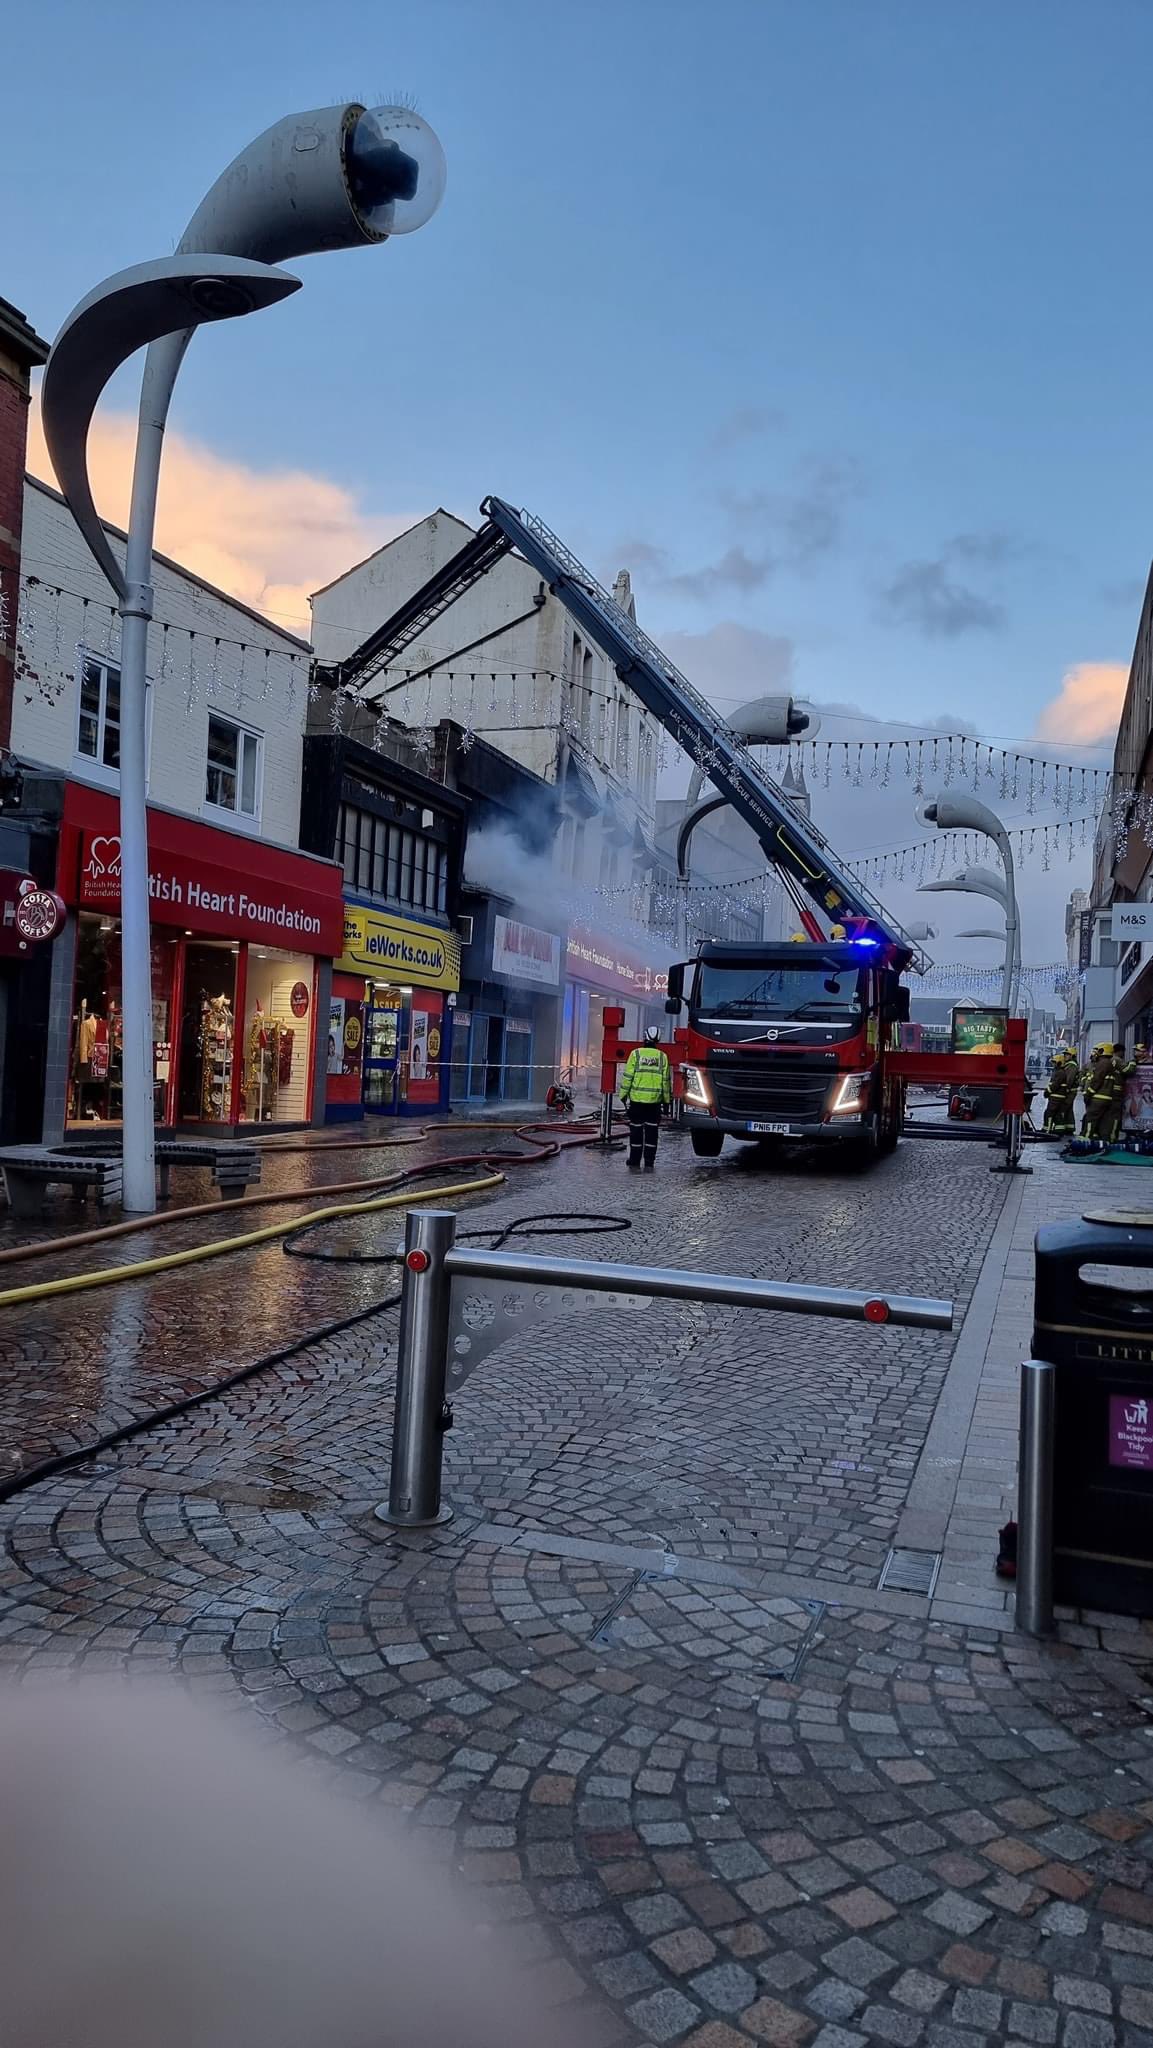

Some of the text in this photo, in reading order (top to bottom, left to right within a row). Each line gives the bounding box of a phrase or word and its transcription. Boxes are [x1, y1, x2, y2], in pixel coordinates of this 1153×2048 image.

[749, 799, 774, 828] SERVICE
[84, 880, 121, 889] British Hea
[84, 889, 121, 897] Foundatio
[24, 894, 51, 908] COSTA
[148, 873, 321, 934] tish Heart Foundation
[1120, 914, 1147, 925] M&S
[20, 919, 53, 936] COFFEE
[344, 930, 362, 939] orks
[366, 934, 442, 968] eWorks.co.uk
[977, 1024, 997, 1033] TASTY
[346, 1030, 359, 1041] SALE
[772, 1124, 788, 1133] FPC
[1126, 1425, 1147, 1434] Keep
[1117, 1431, 1153, 1443] Blackpoo
[1127, 1441, 1145, 1453] Tidy
